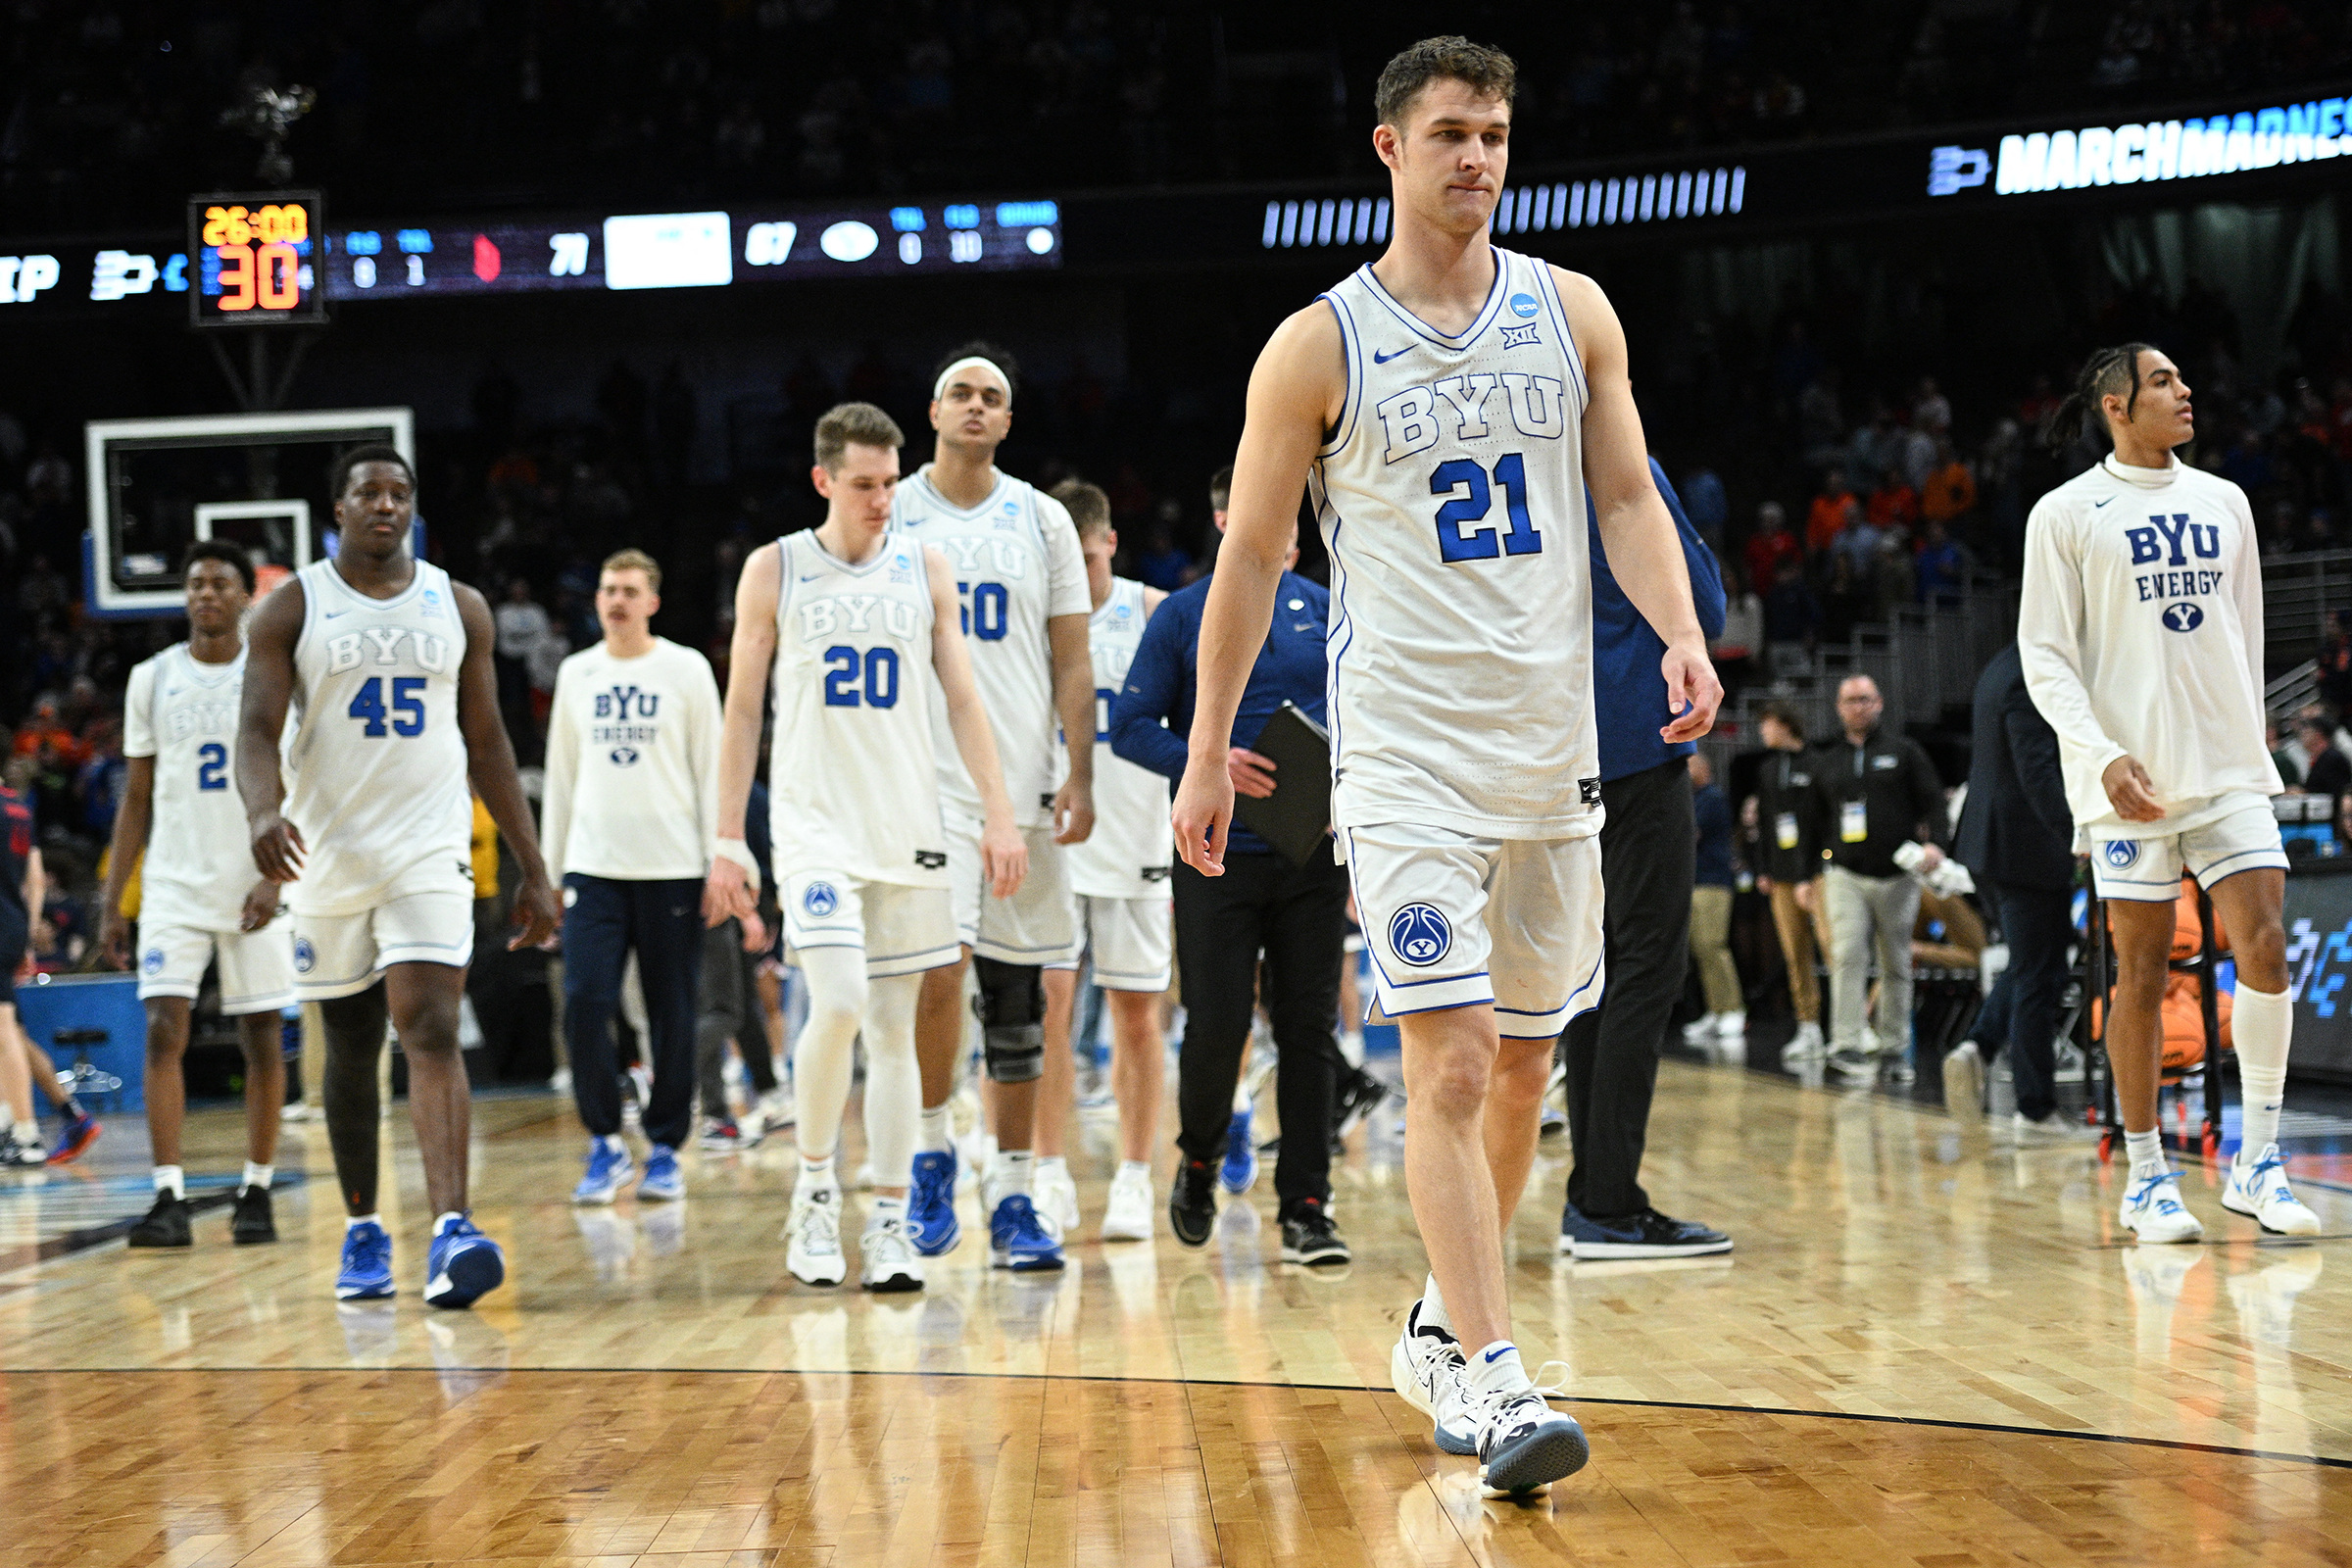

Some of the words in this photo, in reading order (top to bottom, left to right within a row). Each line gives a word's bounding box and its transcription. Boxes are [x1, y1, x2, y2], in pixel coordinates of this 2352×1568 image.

[203, 204, 307, 247] 26:00
[217, 244, 299, 311] 30
[1515, 303, 1538, 312] NCAA
[1377, 372, 1564, 466] BYU
[1430, 452, 1543, 564] 21
[2125, 514, 2220, 566] BYU
[2135, 570, 2224, 602] ENERGY
[799, 594, 918, 644] BYU
[325, 623, 449, 678] BYU
[594, 686, 660, 719] BYU
[824, 646, 899, 709] 20
[161, 702, 241, 747] BY
[349, 677, 427, 738] 45
[198, 743, 227, 790] 2
